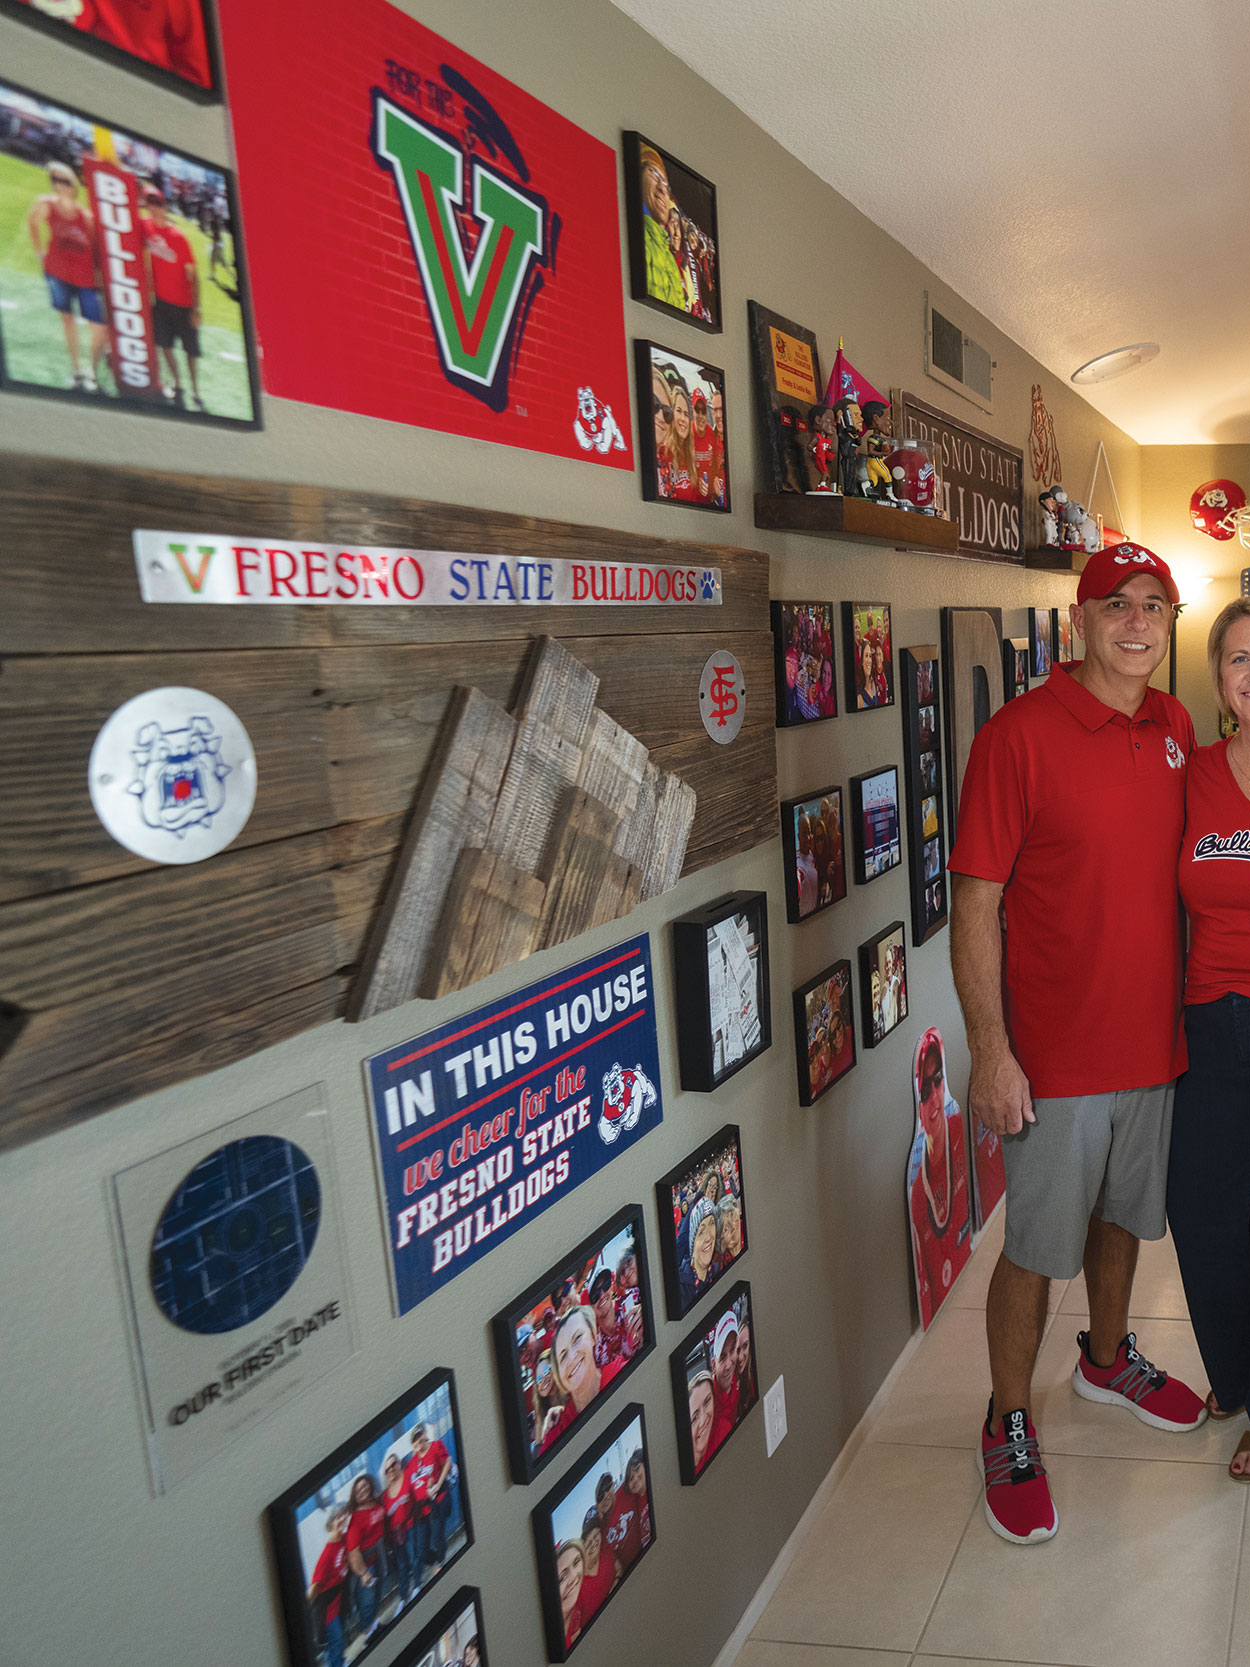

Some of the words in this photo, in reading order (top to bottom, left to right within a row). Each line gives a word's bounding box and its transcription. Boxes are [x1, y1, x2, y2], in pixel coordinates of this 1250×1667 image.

[92, 169, 150, 389] BULLDOGS
[980, 447, 1018, 490] STATE
[168, 543, 215, 593] V
[230, 545, 425, 600] FRESNO
[449, 559, 553, 601] STATE
[571, 564, 697, 602] BULLDOGS
[384, 1069, 436, 1136] IN
[444, 1021, 537, 1100] THIS
[545, 964, 648, 1050] HOUSE
[397, 1145, 514, 1250] FRESNO
[522, 1096, 592, 1167] STATE
[403, 1149, 445, 1196] we
[448, 1106, 515, 1169] cheer
[515, 1085, 550, 1139] for
[555, 1064, 587, 1101] the
[431, 1150, 571, 1274] BULLDOGS
[168, 1381, 223, 1427] OUR
[222, 1335, 288, 1391] FIRST
[288, 1300, 342, 1347] DATE
